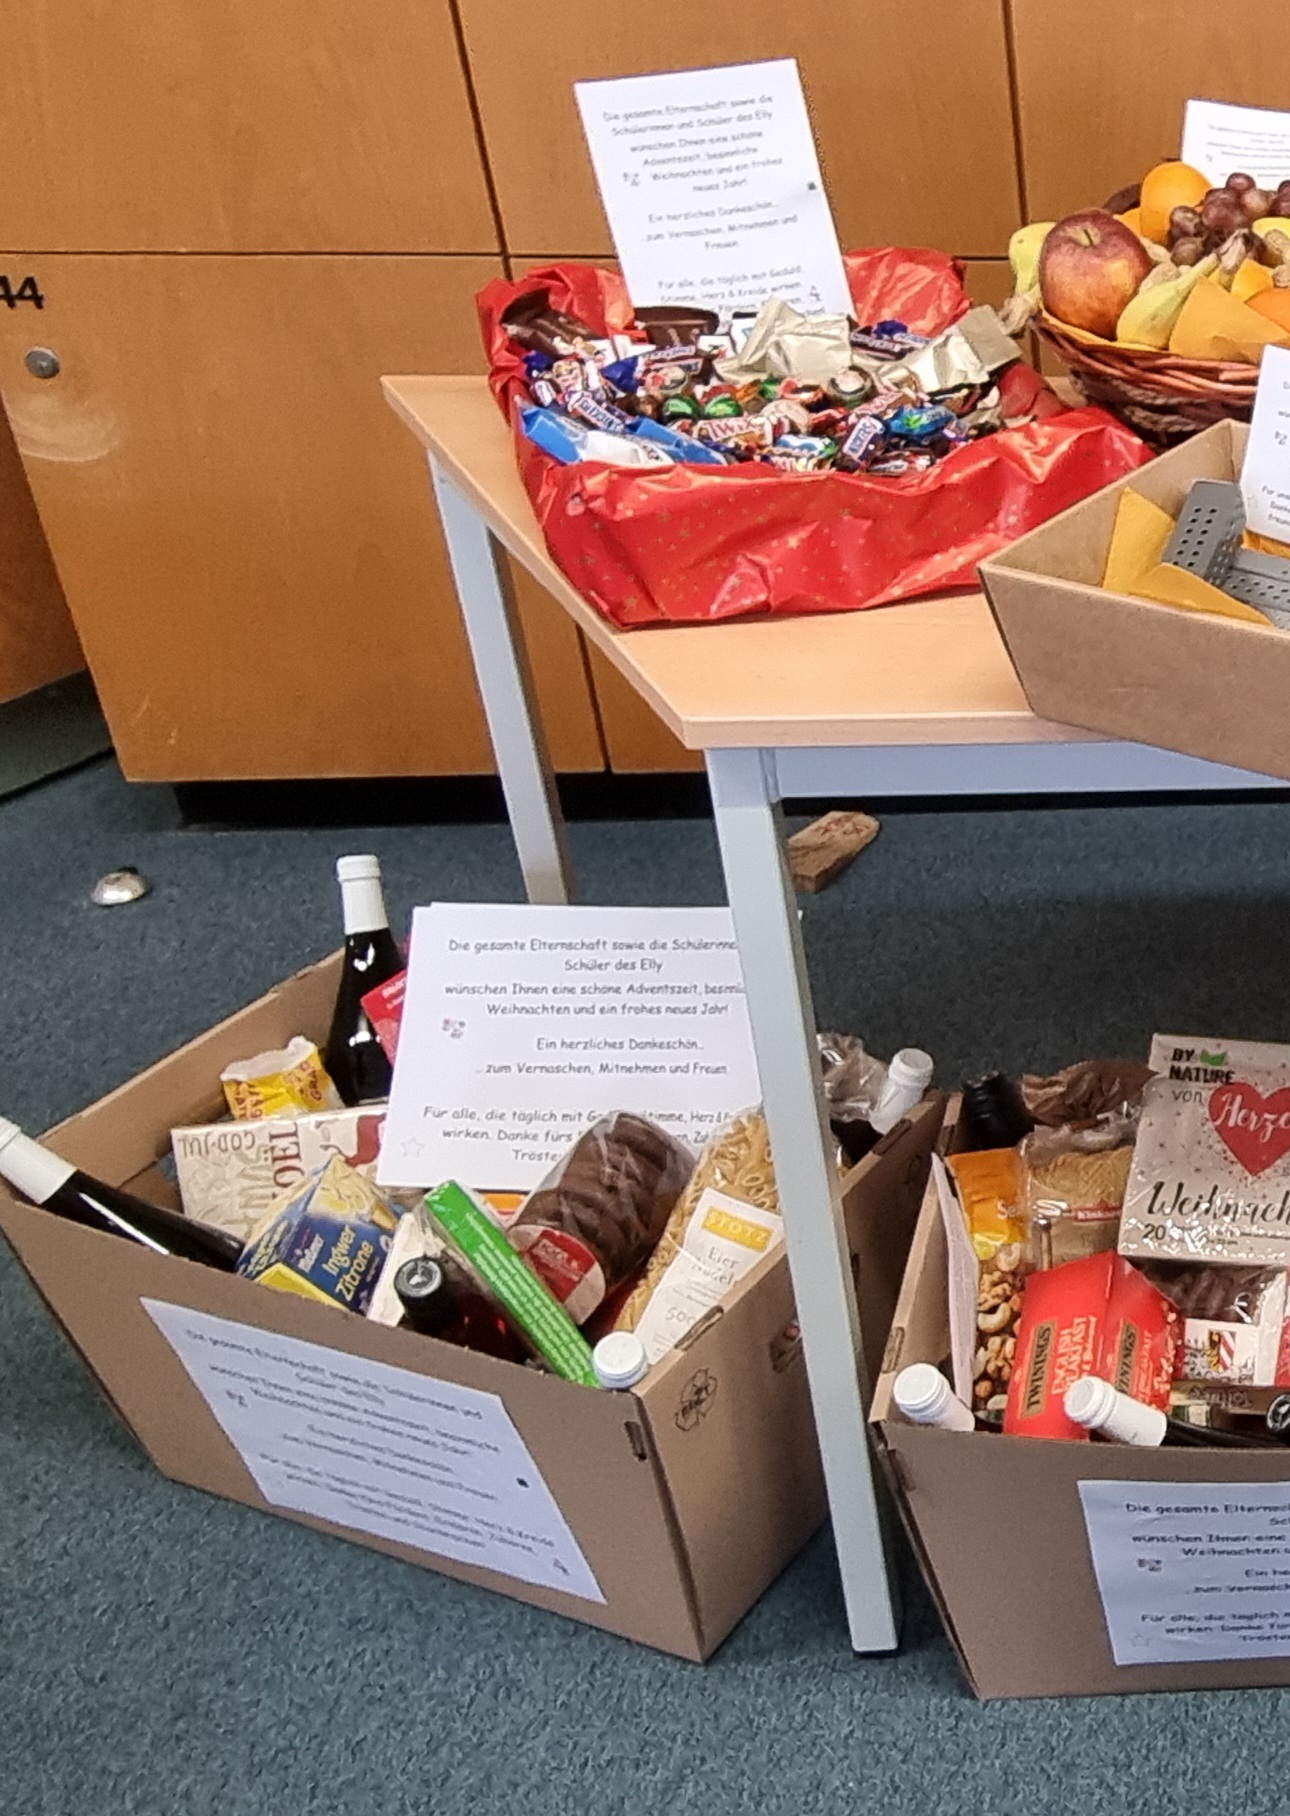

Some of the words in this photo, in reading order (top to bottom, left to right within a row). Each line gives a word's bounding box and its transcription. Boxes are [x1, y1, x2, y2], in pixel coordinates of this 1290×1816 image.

[448, 938, 469, 950] Die
[474, 940, 525, 953] gesamte
[529, 938, 607, 950] Elternschaft
[611, 941, 645, 950] sowie
[648, 939, 667, 950] die
[564, 959, 610, 970] Schüler
[614, 958, 636, 970] des
[639, 958, 662, 972] Elly
[444, 983, 507, 994] wünschen
[512, 982, 548, 994] Ihnen
[551, 986, 576, 994] eine
[486, 1003, 570, 1014] Weihnachten
[573, 1004, 595, 1015] und
[598, 1005, 617, 1014] ein
[620, 1002, 661, 1014] frohes
[664, 1005, 697, 1014] neues
[536, 1037, 556, 1050] Ein
[560, 1038, 624, 1050] herzliches
[1171, 1048, 1196, 1062] BY
[516, 1062, 594, 1074] Vernaschen,
[598, 1062, 666, 1073] Mitnehmen
[669, 1062, 689, 1073] und
[1168, 1065, 1236, 1084] NATURE
[1171, 1089, 1204, 1103] von
[423, 1105, 448, 1118] Für
[484, 1109, 505, 1120] die
[561, 1111, 582, 1122] mit
[496, 1128, 538, 1141] Danke
[544, 1129, 572, 1142] fürs
[512, 1148, 561, 1162] Tröste
[321, 1224, 356, 1277] Ingwer
[335, 1240, 374, 1302] Zitrone
[1026, 1327, 1051, 1409] TWININGS
